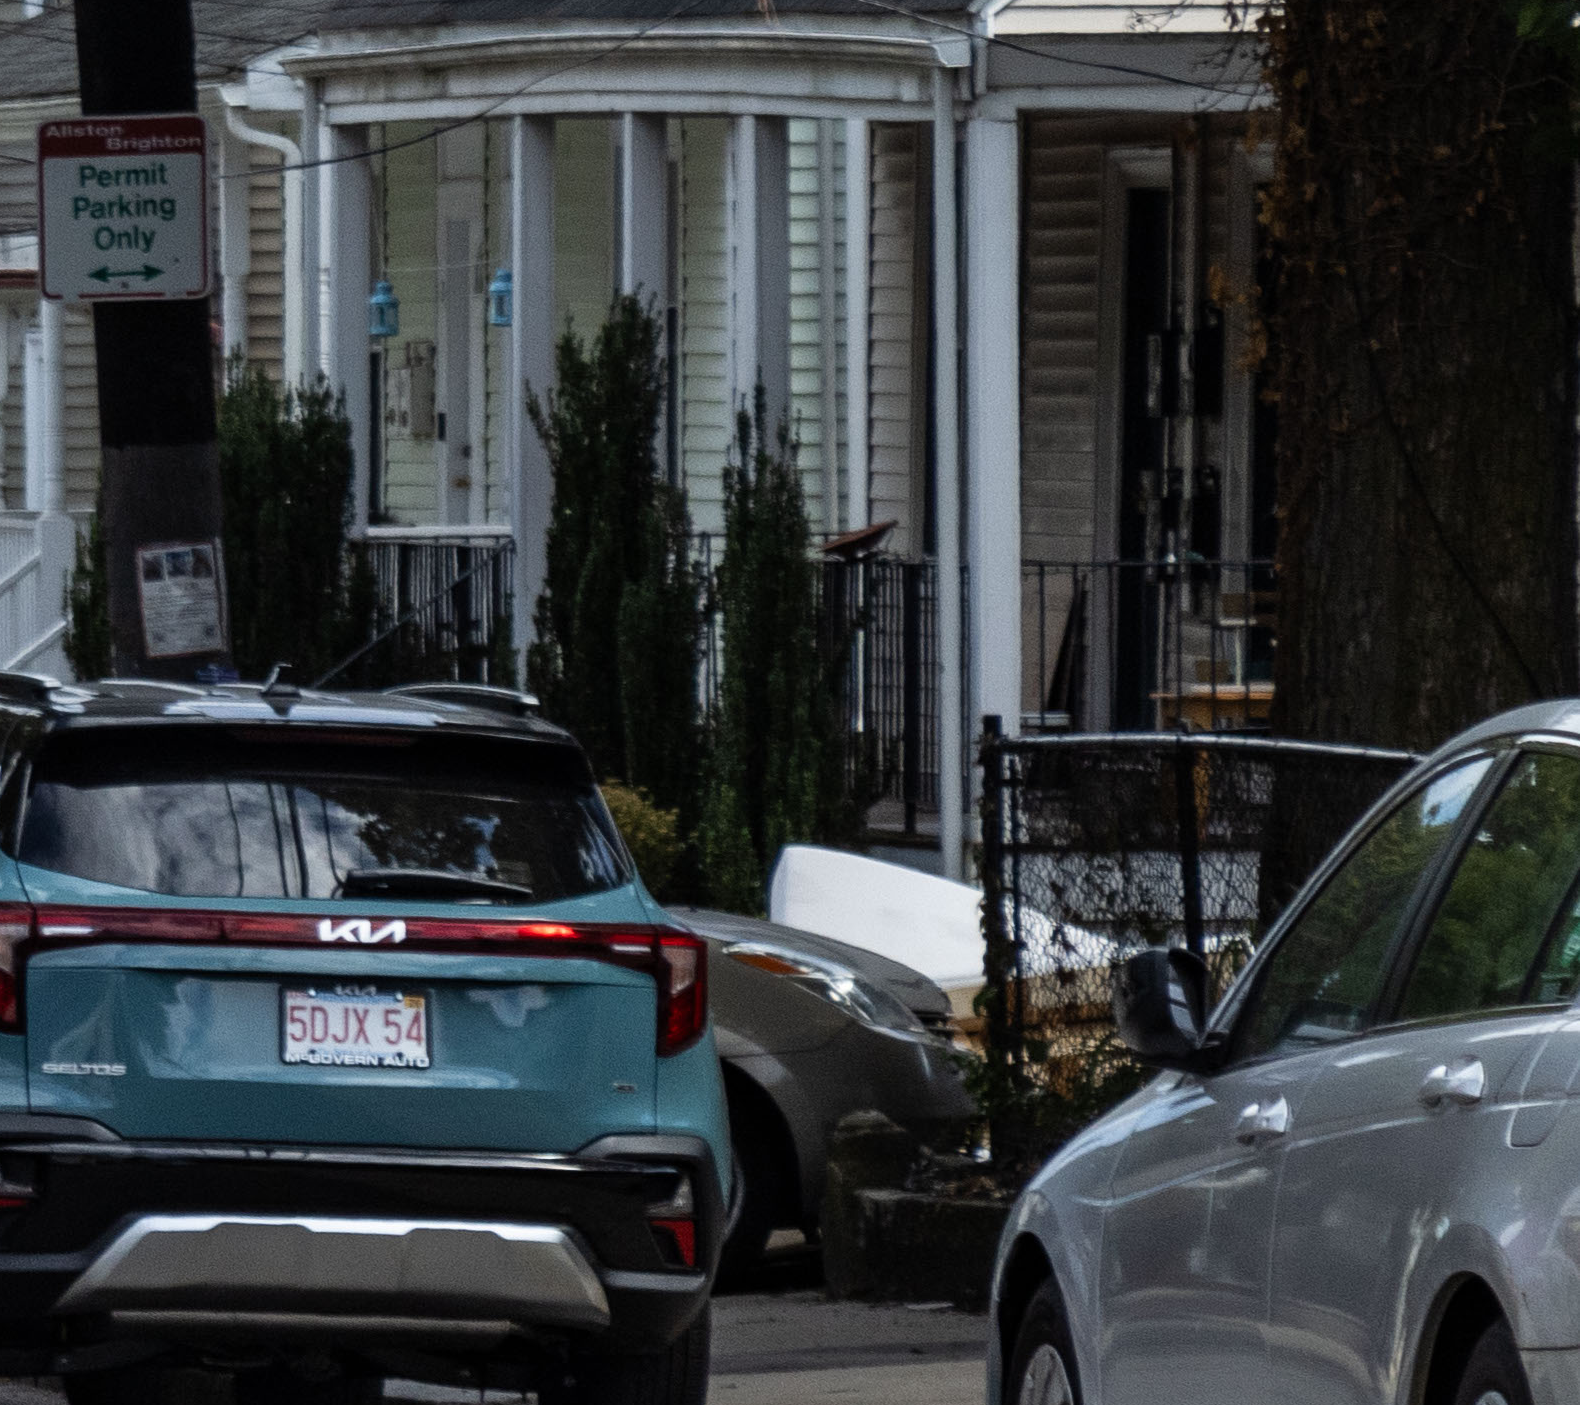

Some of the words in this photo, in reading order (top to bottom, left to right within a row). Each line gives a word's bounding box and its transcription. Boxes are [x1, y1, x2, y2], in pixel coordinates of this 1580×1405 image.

[46, 124, 124, 138] Allston
[106, 134, 202, 151] Brighton
[79, 162, 168, 188] Permit
[72, 194, 177, 222] Parking
[94, 225, 156, 254] Only
[318, 918, 407, 944] KIA
[289, 1005, 370, 1044] 5DJX
[383, 1009, 423, 1045] 54
[42, 1063, 127, 1076] SELTOS
[384, 1056, 430, 1068] AUTO
